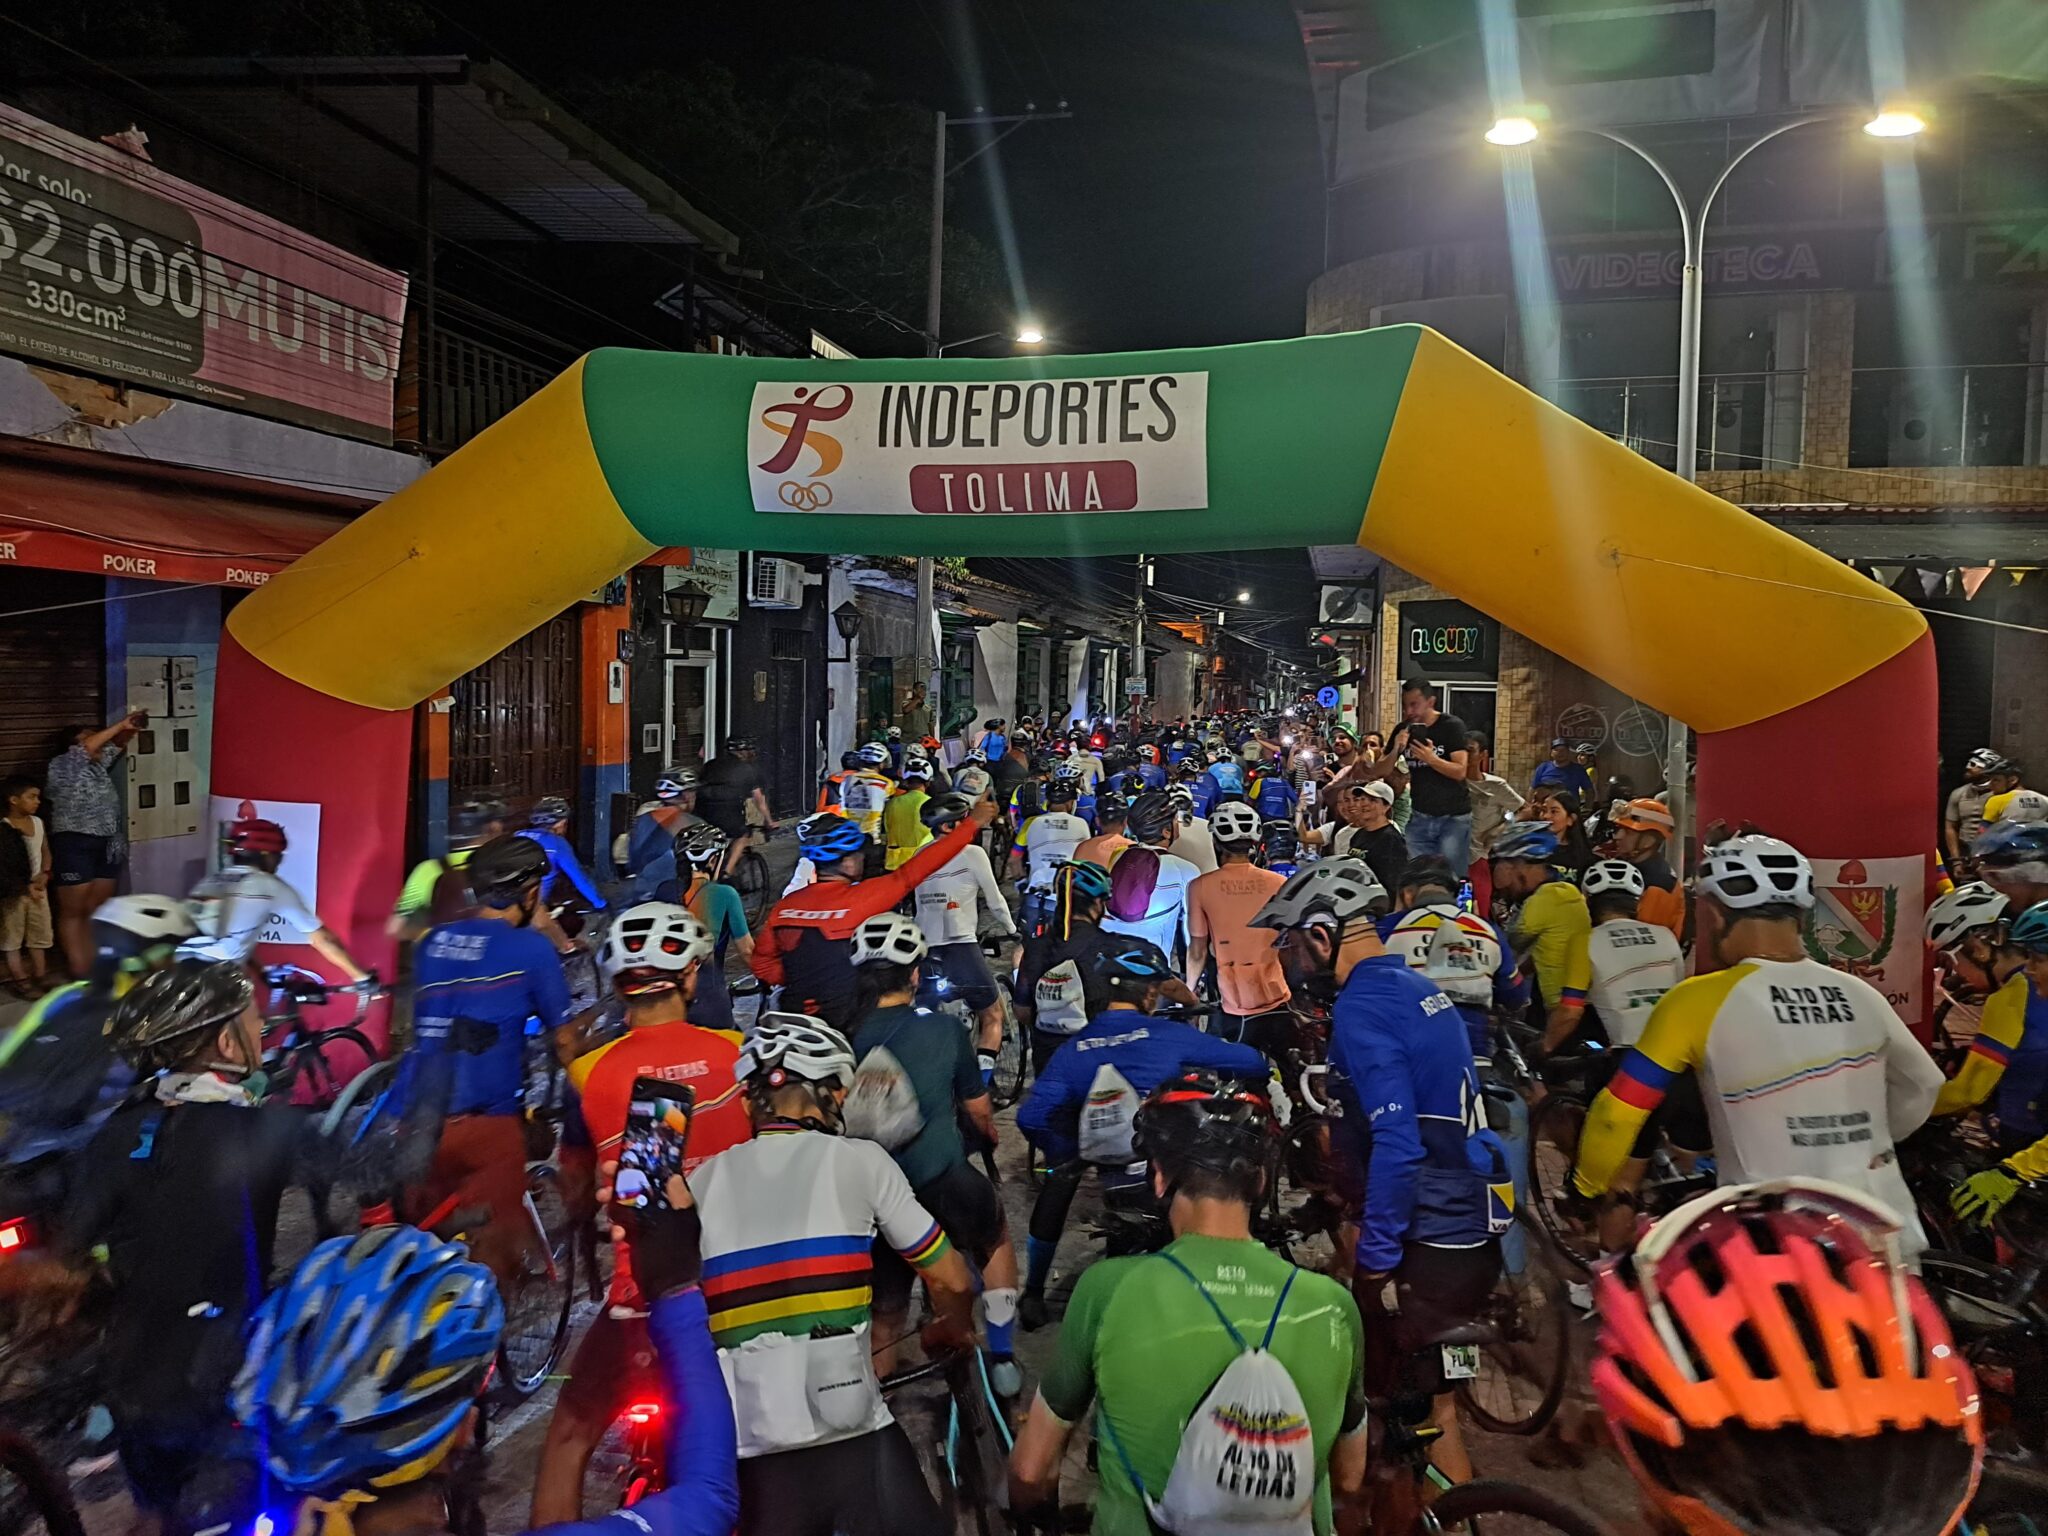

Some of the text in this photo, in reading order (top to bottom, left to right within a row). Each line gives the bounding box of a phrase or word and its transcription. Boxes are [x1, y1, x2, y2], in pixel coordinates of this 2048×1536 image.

[38, 174, 92, 207] solo:
[204, 254, 390, 382] MUTIS
[877, 375, 1178, 449] INDEPORTES
[940, 470, 1104, 513] TOLIMA
[103, 553, 157, 576] POKER
[1410, 628, 1431, 654] EL
[778, 908, 852, 920] SCOTT
[1769, 984, 1849, 1004] ALTO DE
[1772, 1003, 1856, 1025] LETRAS
[1216, 1264, 1246, 1282] RETO
[1222, 1441, 1270, 1472] ALTO
[1216, 1464, 1296, 1500] LETRAS
